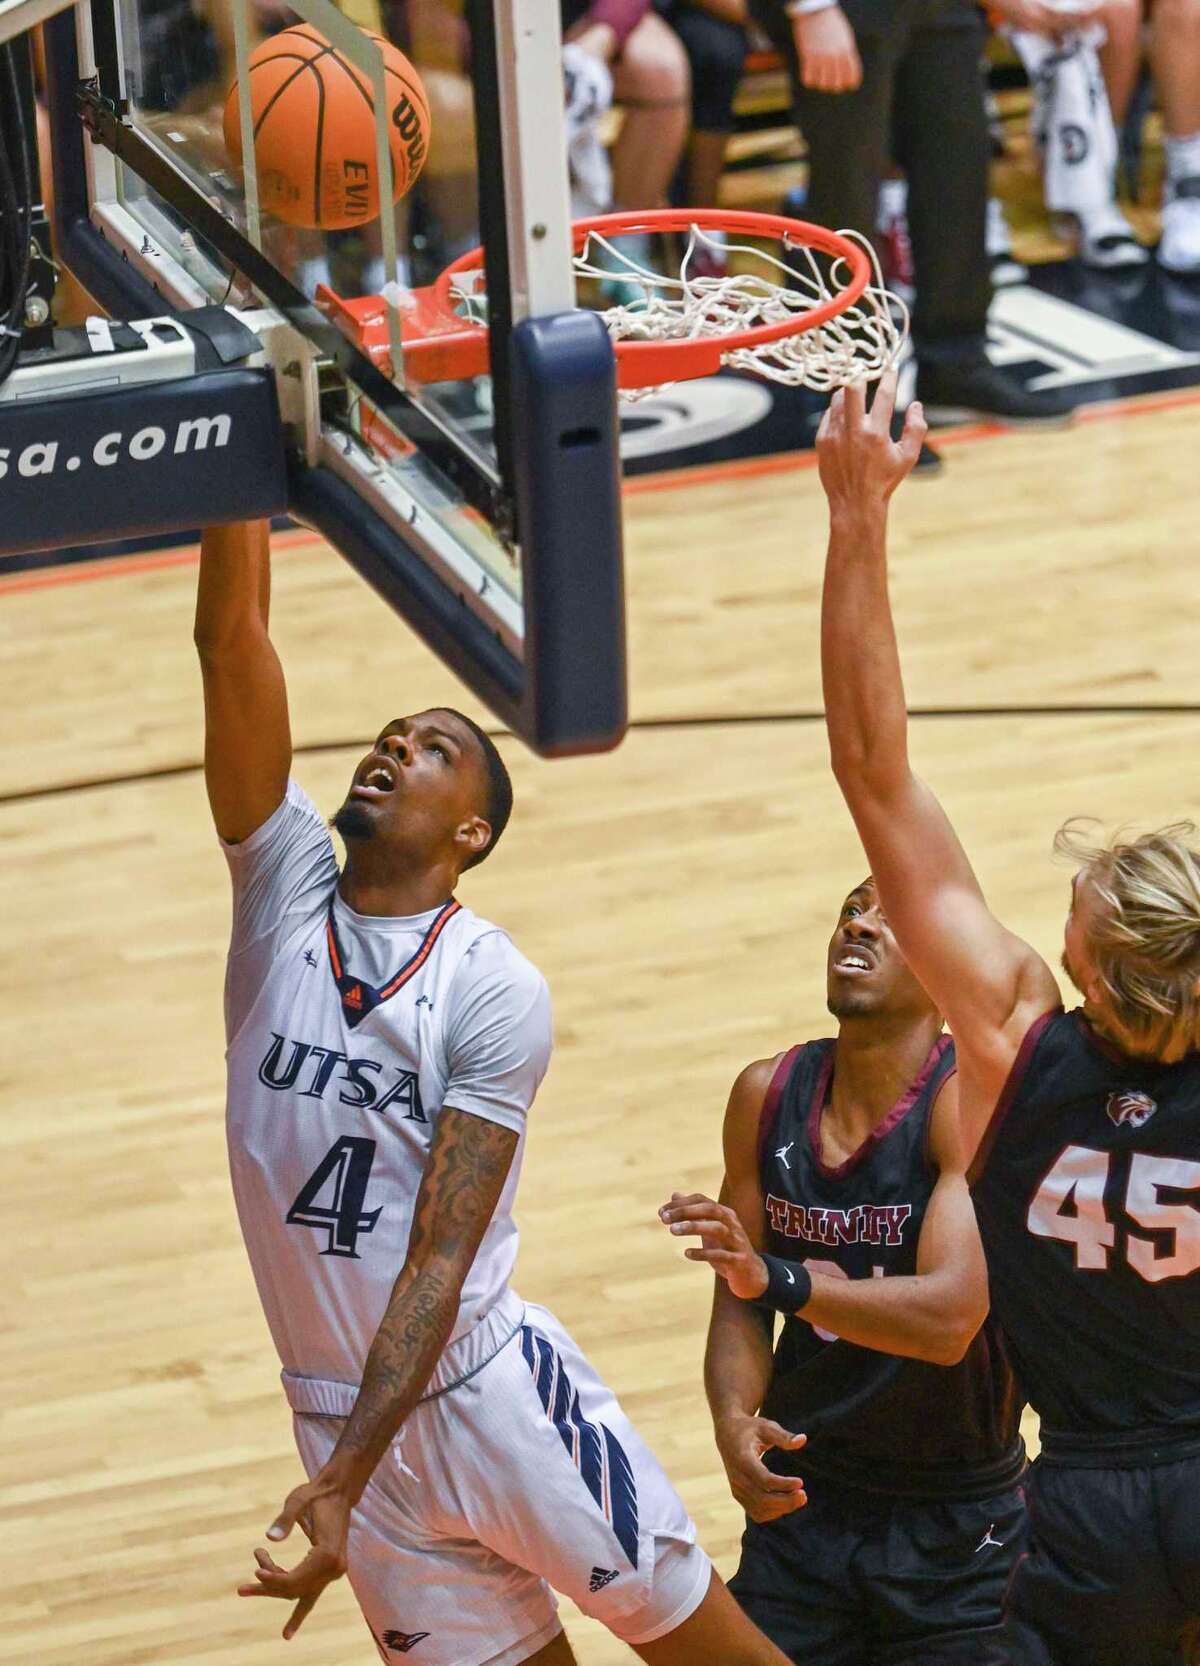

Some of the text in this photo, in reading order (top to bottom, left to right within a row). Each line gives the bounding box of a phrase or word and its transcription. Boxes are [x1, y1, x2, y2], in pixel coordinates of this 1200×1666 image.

[258, 1031, 429, 1124] UTSA
[286, 1135, 384, 1259] 4
[766, 1193, 912, 1246] TRINITY
[1027, 1145, 1200, 1283] 45
[589, 1569, 620, 1593] adidas
